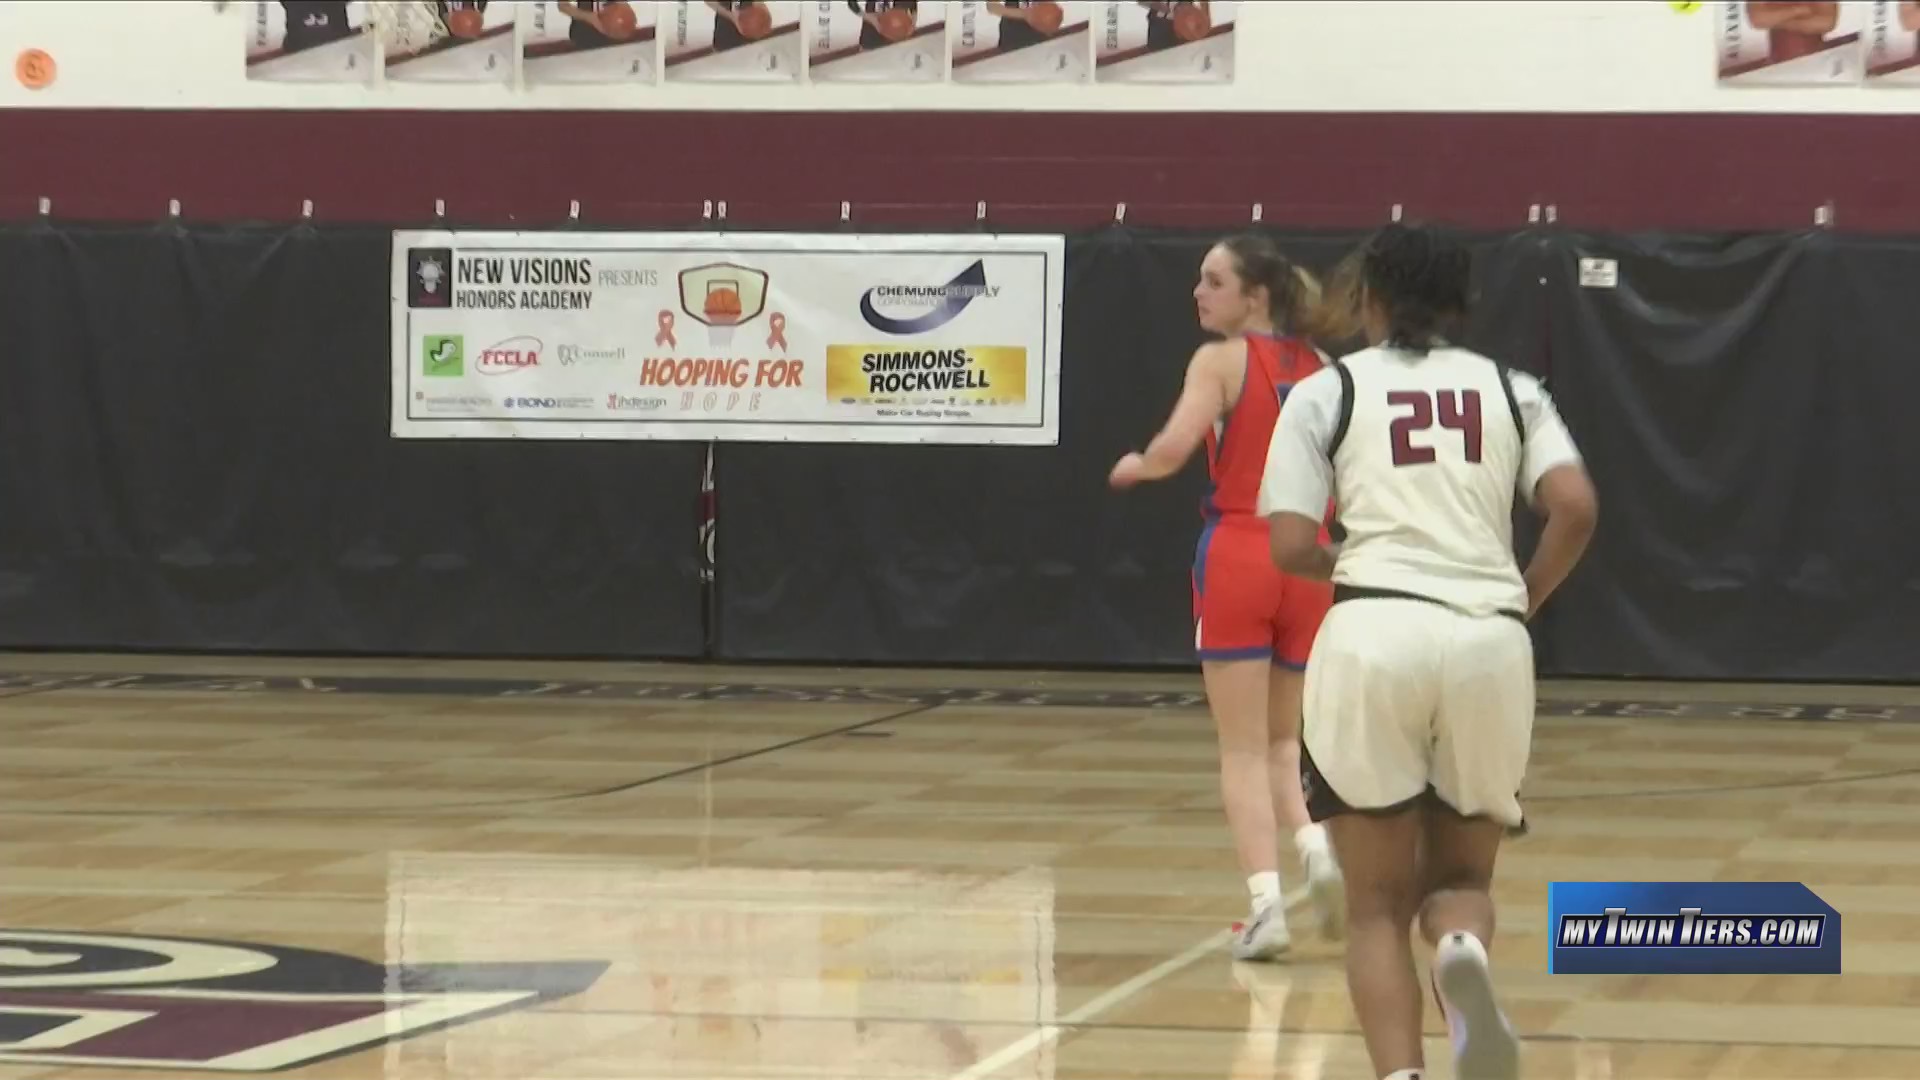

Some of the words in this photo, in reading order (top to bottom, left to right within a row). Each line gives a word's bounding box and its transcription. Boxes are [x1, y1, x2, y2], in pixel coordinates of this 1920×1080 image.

[458, 257, 504, 285] NEW
[509, 258, 592, 285] VISIONS
[598, 270, 658, 286] PRESENTS
[456, 290, 516, 309] HONORS
[520, 290, 592, 310] ACADEMY
[483, 350, 538, 366] FCCLA
[862, 349, 973, 373] SIMMONS-
[640, 357, 749, 388] HOOPING
[754, 358, 804, 388] FOR
[869, 370, 990, 393] ROCKWELL
[517, 398, 556, 408] BOND
[680, 391, 761, 412] HOPE
[1387, 389, 1482, 466] 24
